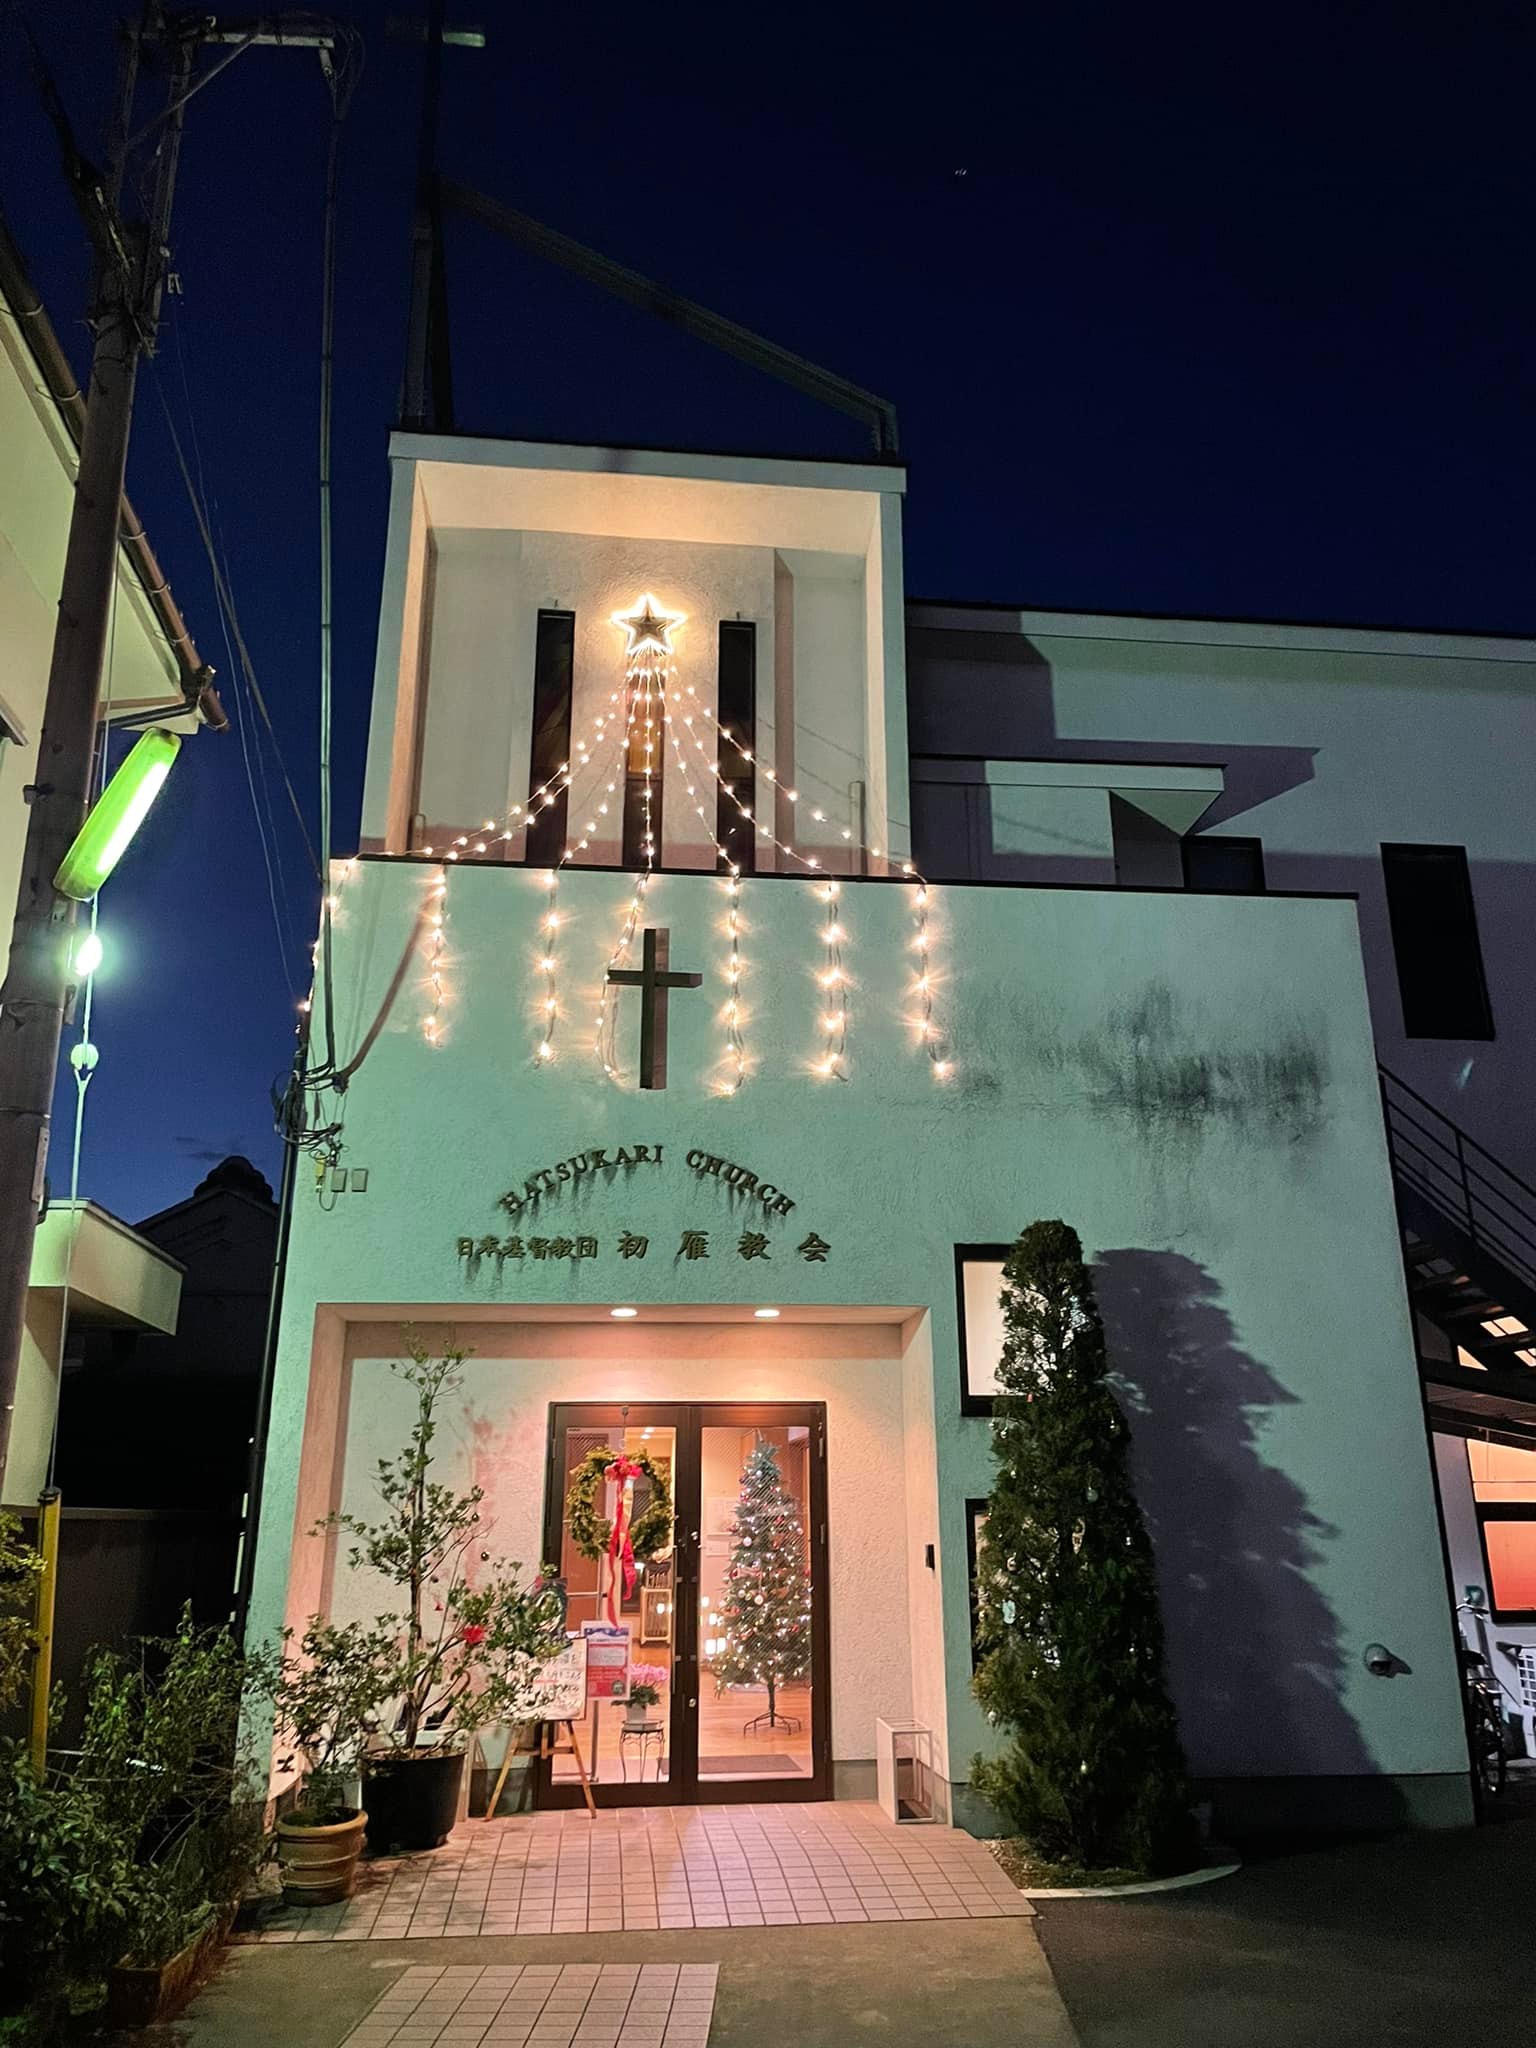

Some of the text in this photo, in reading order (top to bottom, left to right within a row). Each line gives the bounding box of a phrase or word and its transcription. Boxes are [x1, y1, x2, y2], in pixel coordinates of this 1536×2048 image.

[498, 1145, 796, 1217] HATSUKARI CHURCH
[456, 1234, 599, 1260] 日本基督教団
